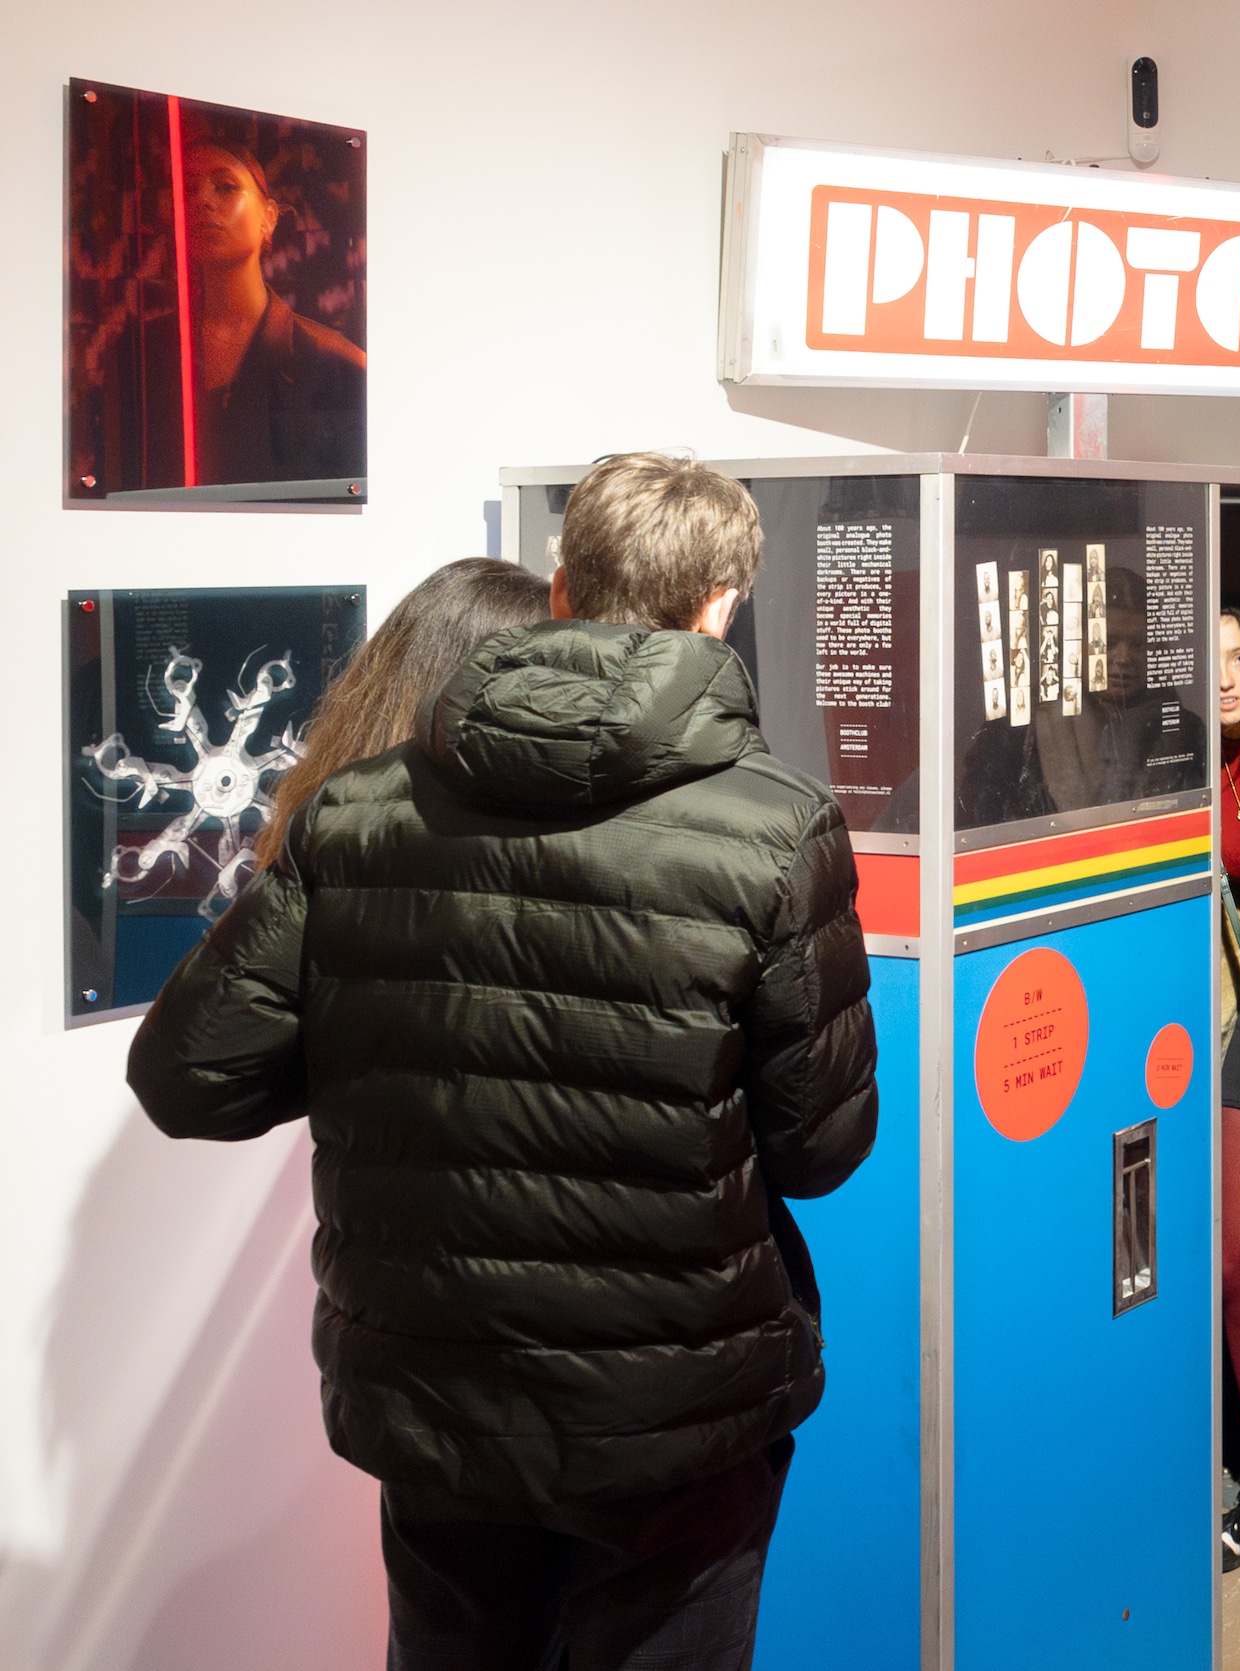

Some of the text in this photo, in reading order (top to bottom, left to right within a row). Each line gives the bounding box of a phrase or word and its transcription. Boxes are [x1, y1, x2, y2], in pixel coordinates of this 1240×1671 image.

[1024, 988, 1042, 1006] B/W
[1012, 1024, 1054, 1049] 1 STRIP
[1003, 1060, 1063, 1093] 5 MIN WAIT
